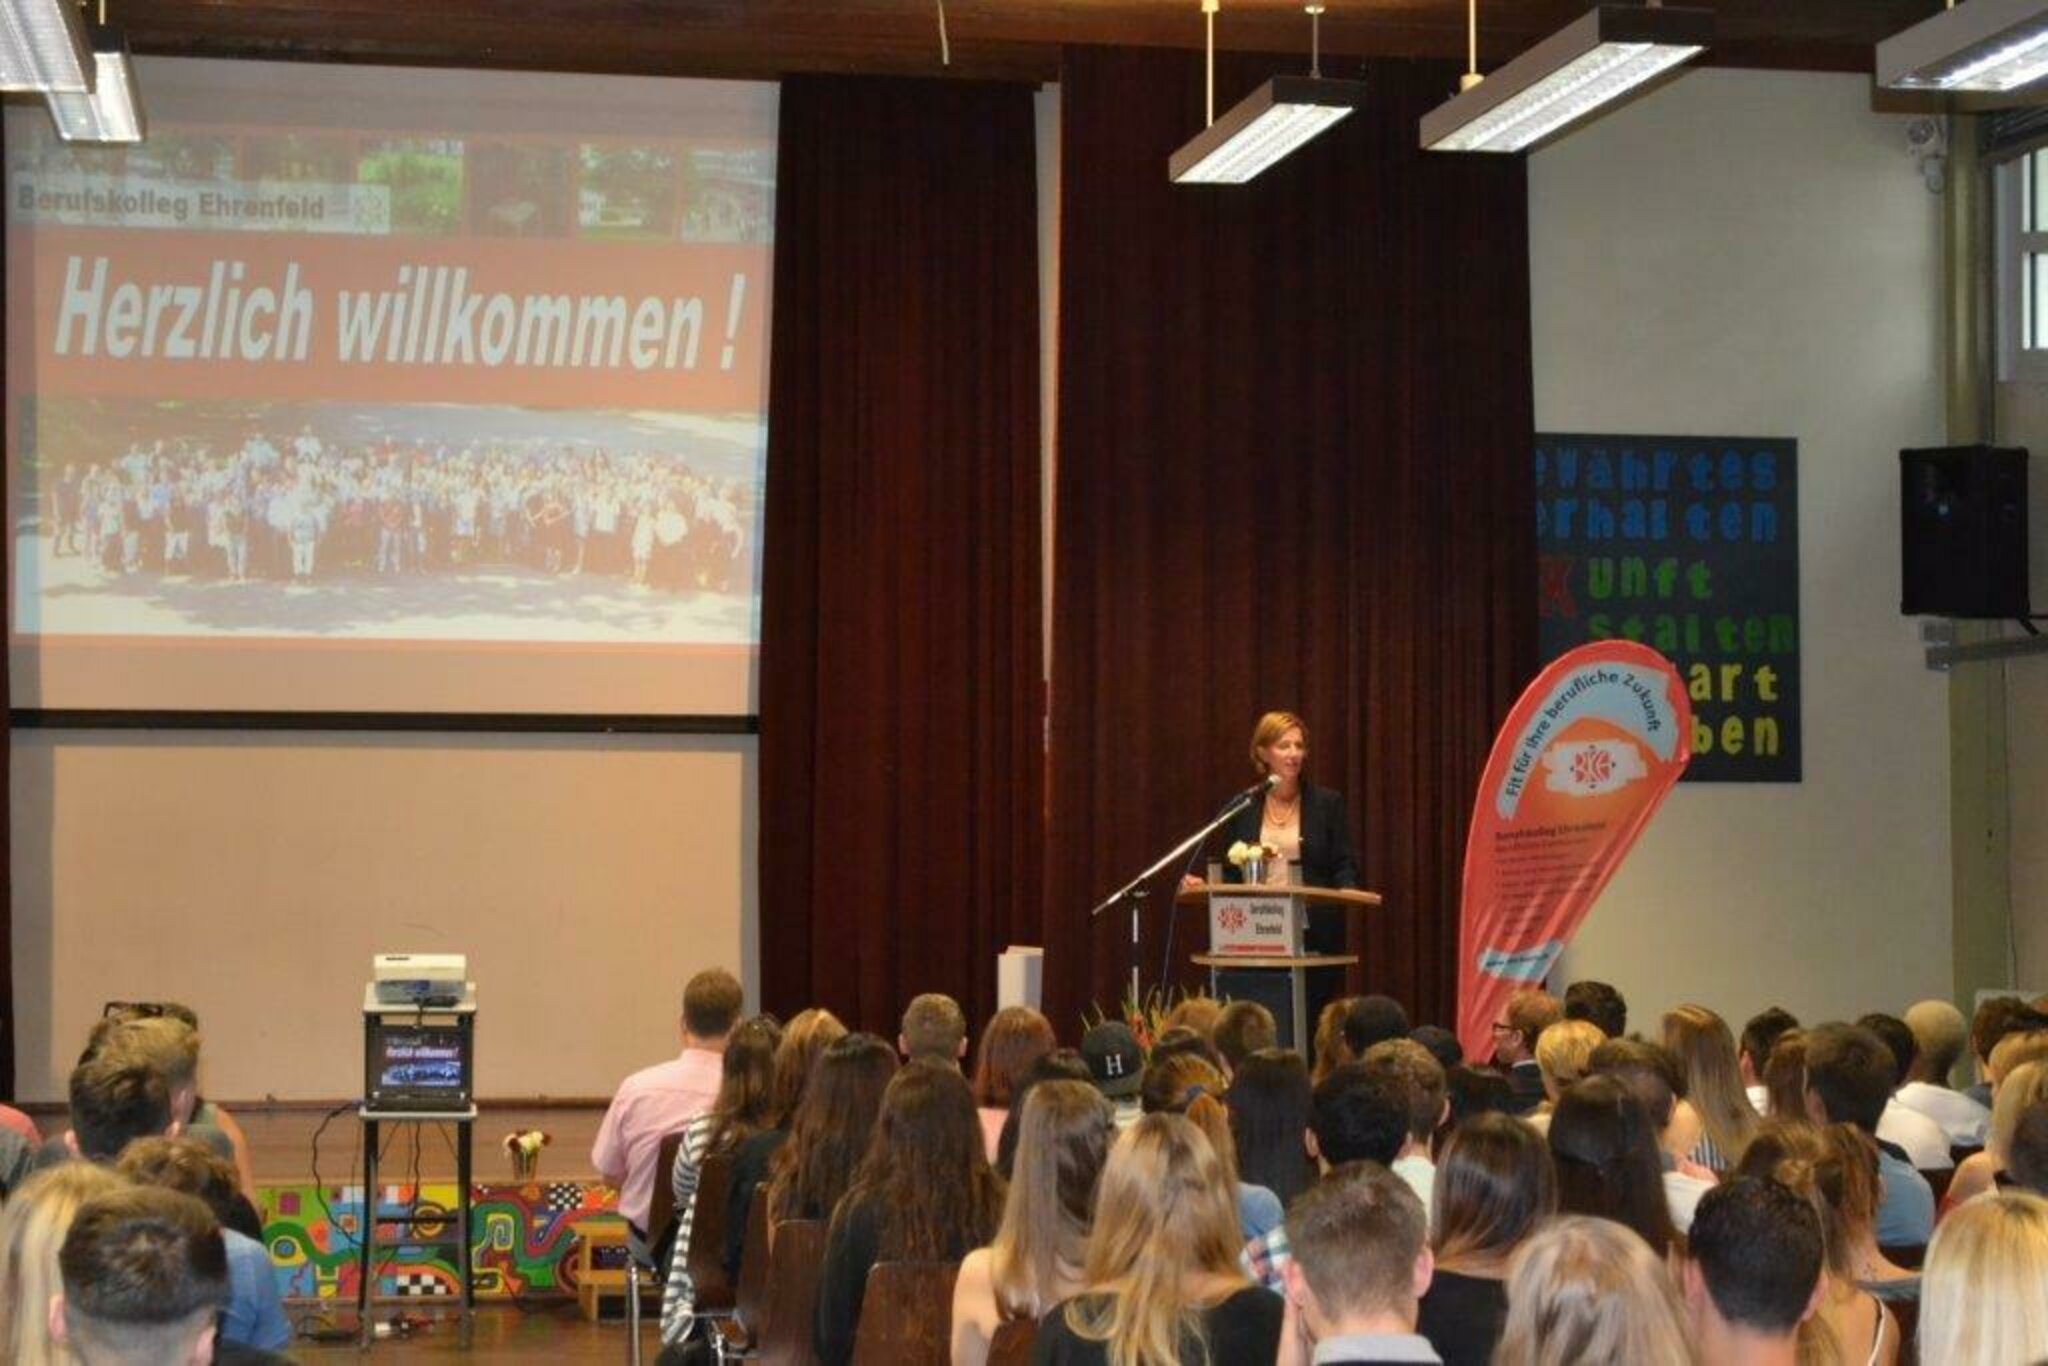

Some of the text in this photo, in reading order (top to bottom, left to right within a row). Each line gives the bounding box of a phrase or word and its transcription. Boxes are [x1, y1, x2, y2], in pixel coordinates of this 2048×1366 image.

[17, 184, 325, 221] Berufskolleg Ehrenfeld
[55, 255, 313, 361] Herzlich
[337, 264, 703, 370] willkommen
[1547, 669, 1619, 719] berufliche
[1688, 663, 1779, 702] art
[1622, 673, 1662, 732] Zukunft
[1689, 715, 1779, 756] ben
[1514, 752, 1531, 774] für
[1506, 777, 1523, 796] Fit
[1105, 1053, 1123, 1075] H
